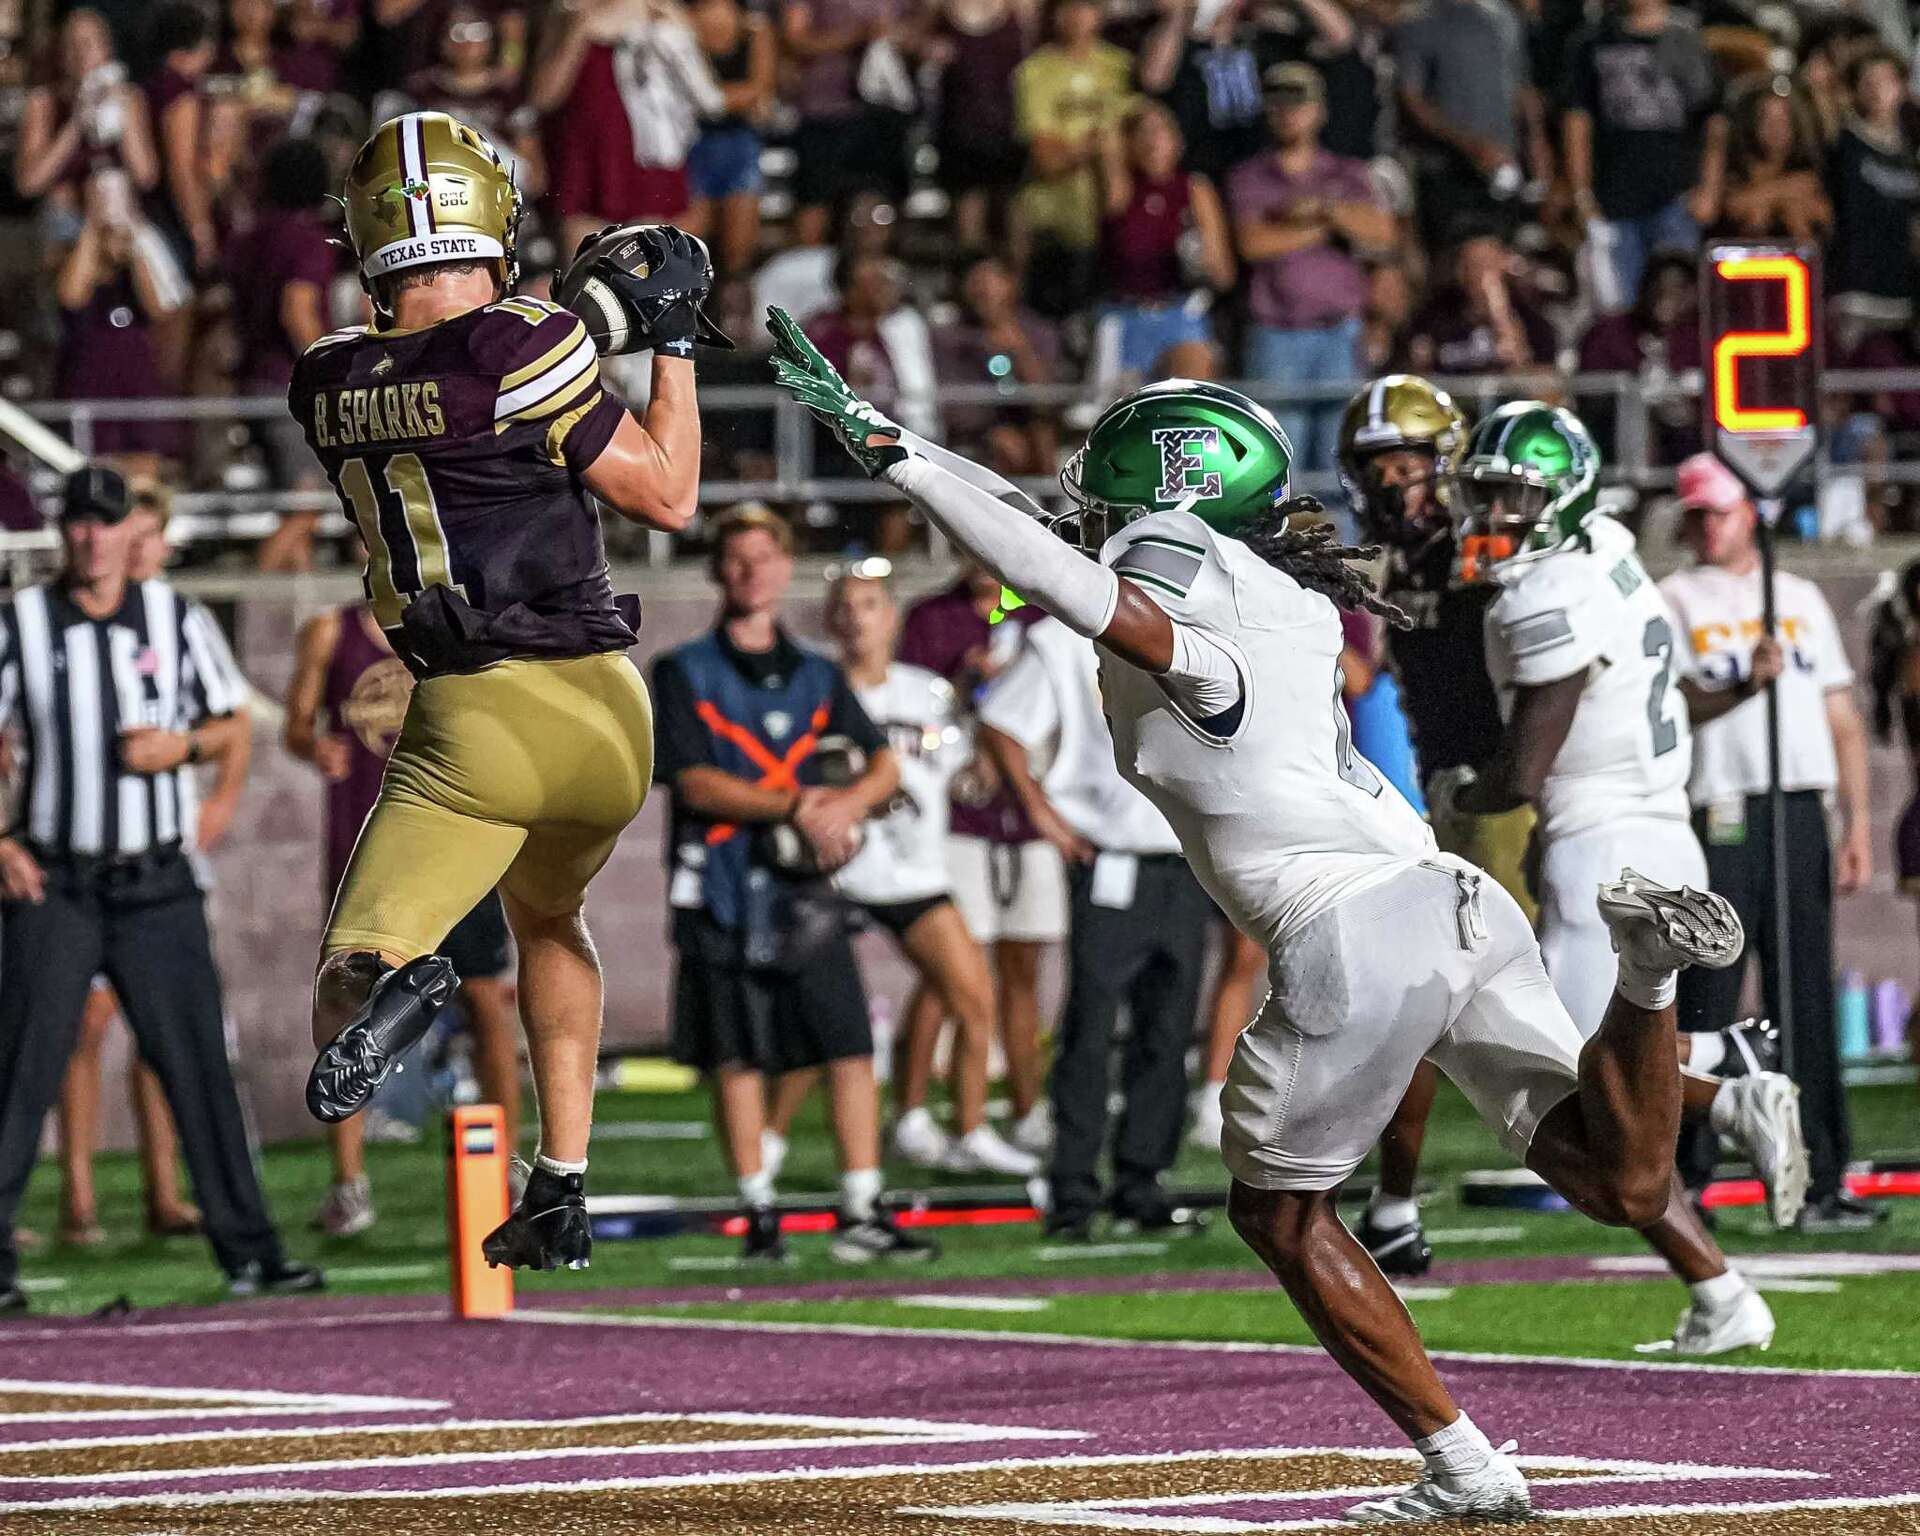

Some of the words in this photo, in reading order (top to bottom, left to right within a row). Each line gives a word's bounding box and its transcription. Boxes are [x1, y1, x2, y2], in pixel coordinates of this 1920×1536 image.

[380, 242, 427, 268] TEXAS
[430, 238, 478, 255] STATE
[1713, 255, 1812, 432] 2
[338, 381, 446, 444] SPARKS
[1152, 427, 1223, 503] E
[338, 452, 471, 631] 11
[1642, 614, 1677, 758] 2
